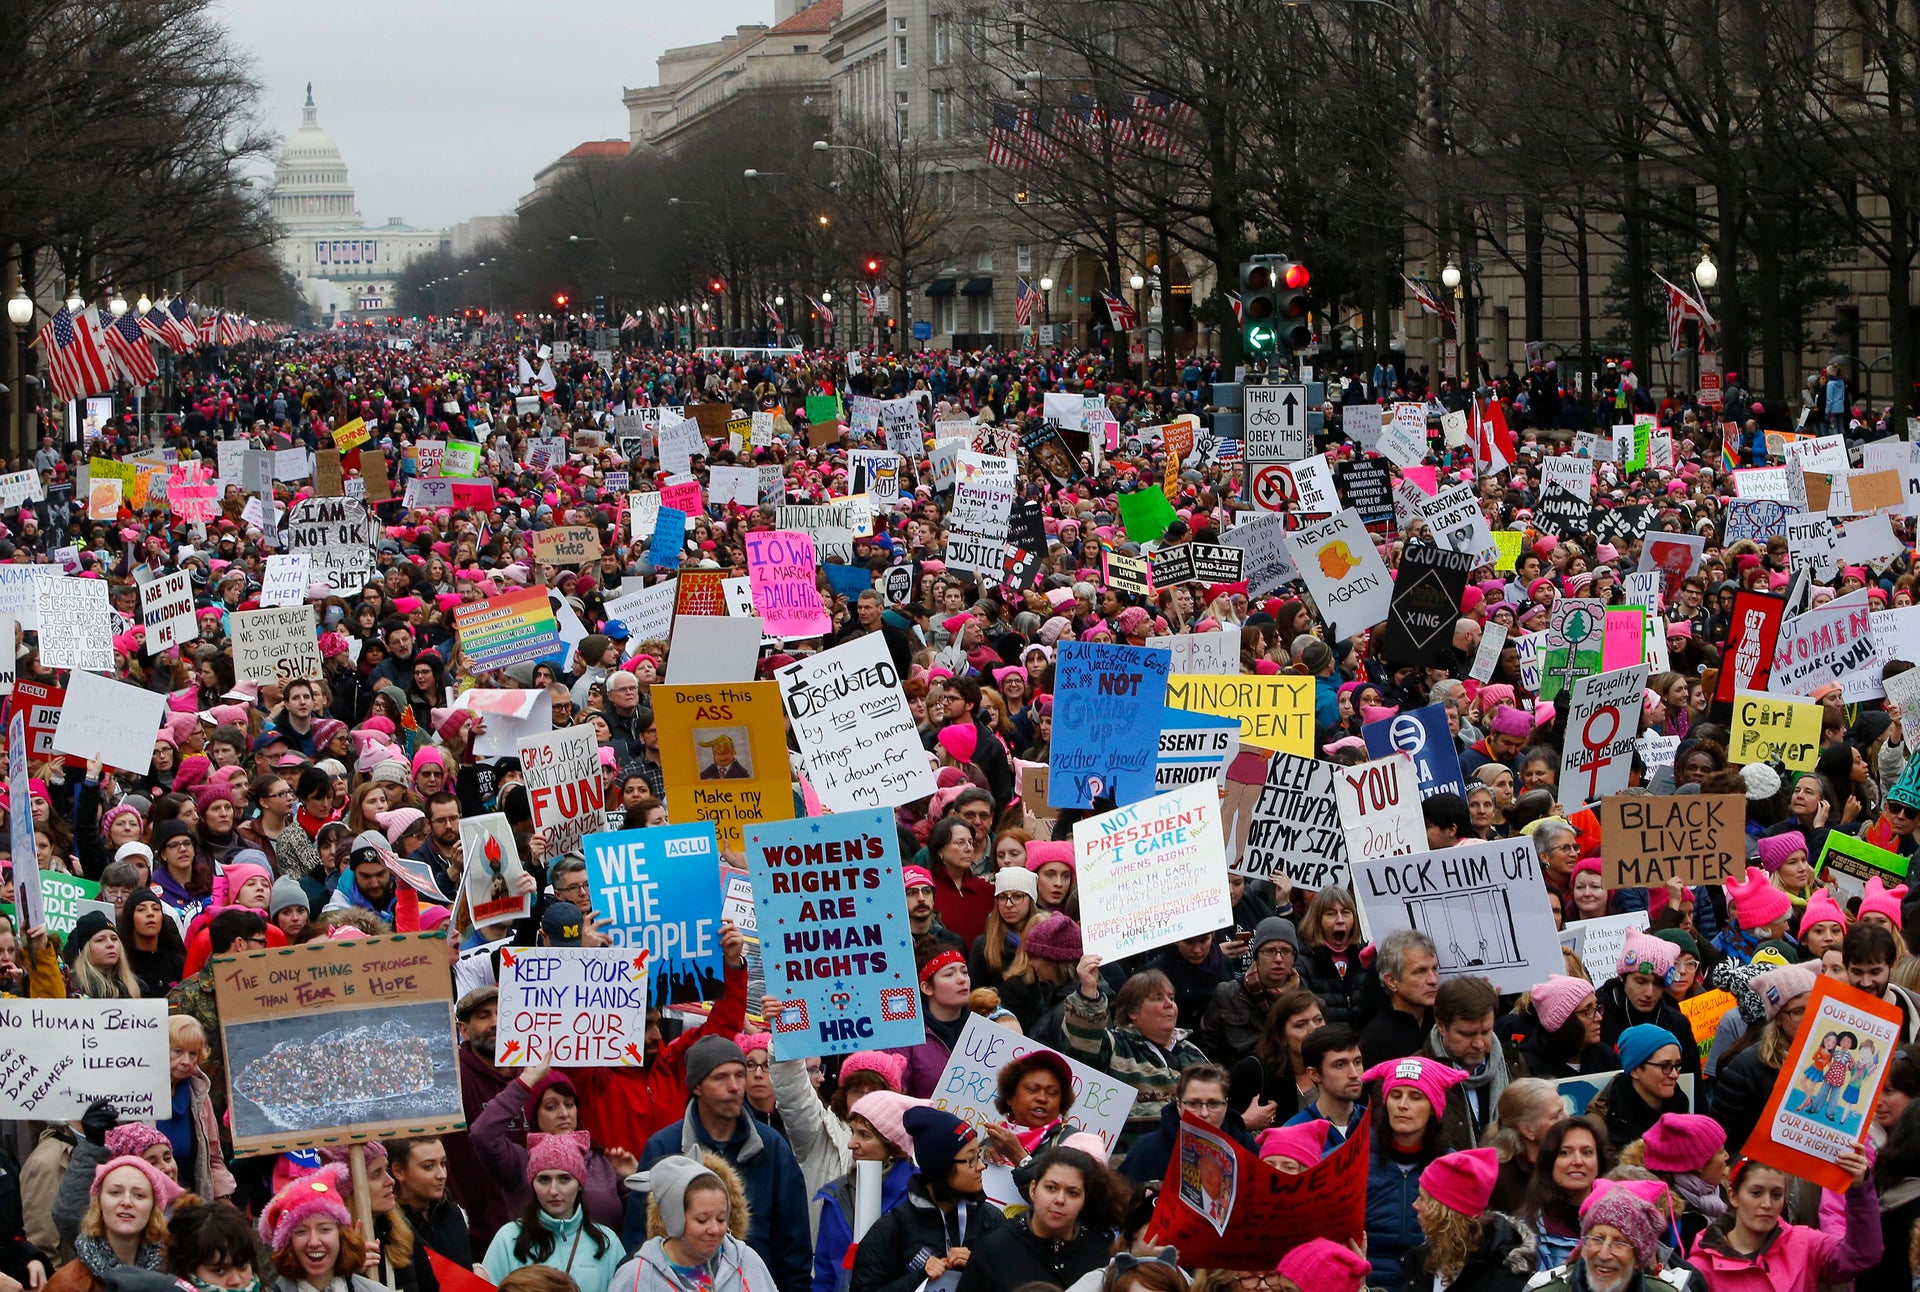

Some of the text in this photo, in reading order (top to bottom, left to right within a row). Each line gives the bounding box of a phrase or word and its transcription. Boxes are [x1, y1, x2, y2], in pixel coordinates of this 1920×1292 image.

[1249, 391, 1276, 402] THRU
[336, 425, 368, 444] FEMINIST
[891, 424, 912, 432] WITH
[895, 432, 911, 440] HER
[1166, 426, 1191, 435] WOMEN
[1167, 433, 1191, 443] WON'T
[1249, 430, 1303, 441] OBEY THIS
[1169, 440, 1190, 451] BACK
[1249, 445, 1285, 456] SIGNAL
[982, 460, 1006, 468] MIND
[1295, 466, 1316, 481] UNITE
[1544, 458, 1591, 475] WOMEN'S
[1299, 480, 1314, 493] THE
[1344, 472, 1361, 480] PEOPLE
[957, 483, 1010, 503] Feminism
[1303, 490, 1325, 505] STATE
[1421, 487, 1472, 518] RESISTANCE
[1546, 486, 1562, 497] NO
[299, 503, 345, 523] I AM
[777, 506, 852, 530] INTOLERANCE
[1432, 504, 1476, 531] LEADS TO
[1543, 500, 1592, 518] HUMAN
[295, 521, 364, 547] NOT OK
[1296, 519, 1349, 548] NEVER
[1569, 519, 1588, 532] IS
[1591, 503, 1659, 544] LOVE IS LOVE
[1789, 521, 1827, 541] FUTURE
[537, 528, 593, 544] Love not
[556, 543, 585, 555] Hate
[748, 540, 814, 571] IOWA
[949, 542, 1004, 570] JUSTICE
[1207, 547, 1239, 561] AM
[1404, 546, 1473, 572] CAUTION
[279, 556, 301, 566] I'M
[1117, 557, 1137, 568] BLACK
[1196, 562, 1238, 572] PRO-LIFE
[1791, 551, 1829, 574] FEMALE
[270, 571, 302, 583] WITH
[328, 570, 369, 590] SHIT
[1119, 568, 1137, 579] LIVES
[38, 576, 106, 595] VOTE NO
[146, 575, 185, 602] ARE YOU
[266, 588, 302, 599] THEM
[1117, 580, 1140, 592] MATTER
[1328, 573, 1379, 607] AGAIN
[39, 594, 108, 611] SESSIONS
[145, 598, 191, 628] KKKIDDING
[613, 599, 643, 614] BEWARE
[40, 611, 111, 625] TILLERSON
[278, 609, 309, 625] BELIEVE
[767, 609, 820, 622] HER FUTURE
[1405, 611, 1440, 628] XING
[239, 623, 307, 643] WE STILL HAVE
[1772, 608, 1870, 671] WOMEN
[263, 642, 314, 661] FIGHT FOR
[1780, 636, 1876, 687] IN CHARGE DUH!
[244, 656, 316, 679] THIS SHIT
[812, 659, 844, 679] am
[787, 662, 898, 719] DISGUSTED
[1099, 673, 1142, 696] NOT
[1166, 682, 1308, 709] MINORITY
[1586, 672, 1639, 698] Equality
[676, 689, 752, 704] Does this
[1575, 692, 1641, 722] Tolerance
[695, 706, 733, 721] ASS
[800, 694, 901, 744] by too many
[1742, 702, 1792, 729] Girl
[521, 735, 592, 771] GIRLS JUST
[810, 717, 915, 770] things to narrow
[1740, 729, 1814, 762] Power
[844, 748, 909, 784] down for
[1052, 748, 1149, 772] neither should
[1565, 746, 1592, 770] HEAR
[523, 759, 600, 790] WANT HAVE
[1266, 752, 1320, 791] KEEP
[694, 790, 762, 809] Make my
[852, 784, 878, 807] my
[1346, 762, 1400, 816] YOU
[531, 775, 605, 828] FUN
[696, 806, 763, 824] sign look
[1100, 804, 1138, 835] NOT
[1620, 801, 1725, 829] BLACK
[716, 827, 741, 840] BIG
[1086, 805, 1207, 856] PRESIDENT
[1134, 827, 1187, 855] CARE
[1363, 816, 1406, 856] don't
[1641, 828, 1717, 853] LIVES
[664, 836, 711, 858] ACLU
[762, 833, 884, 869] WOMEN'S
[596, 843, 650, 885] WE
[1366, 846, 1534, 897] LOCK HIM UP!
[1618, 852, 1732, 881] MATTER
[41, 880, 86, 900] STOP
[772, 868, 881, 893] RIGHTS
[601, 883, 662, 925] THE
[798, 897, 857, 922] ARE
[783, 924, 883, 954] HUMAN
[1121, 918, 1170, 940] HONESTY
[225, 968, 259, 992] THE
[269, 968, 301, 984] ONLY
[362, 955, 432, 973] STRONGER
[514, 958, 632, 983] KEEP YOUR
[786, 952, 888, 982] RIGHTS
[255, 982, 336, 1007] THAN FEAR
[520, 986, 642, 1009] TINY HANDS
[0, 1009, 22, 1028] NO
[32, 1009, 94, 1030] HUMAN
[514, 1012, 625, 1036] OFF OUR
[1823, 1005, 1847, 1023] OUR
[819, 1016, 874, 1042] HRC
[527, 1034, 622, 1063] RIGHTS
[20, 1055, 74, 1112] DREAMERS
[1780, 1113, 1800, 1130] OUR
[1782, 1128, 1803, 1143] OUR
